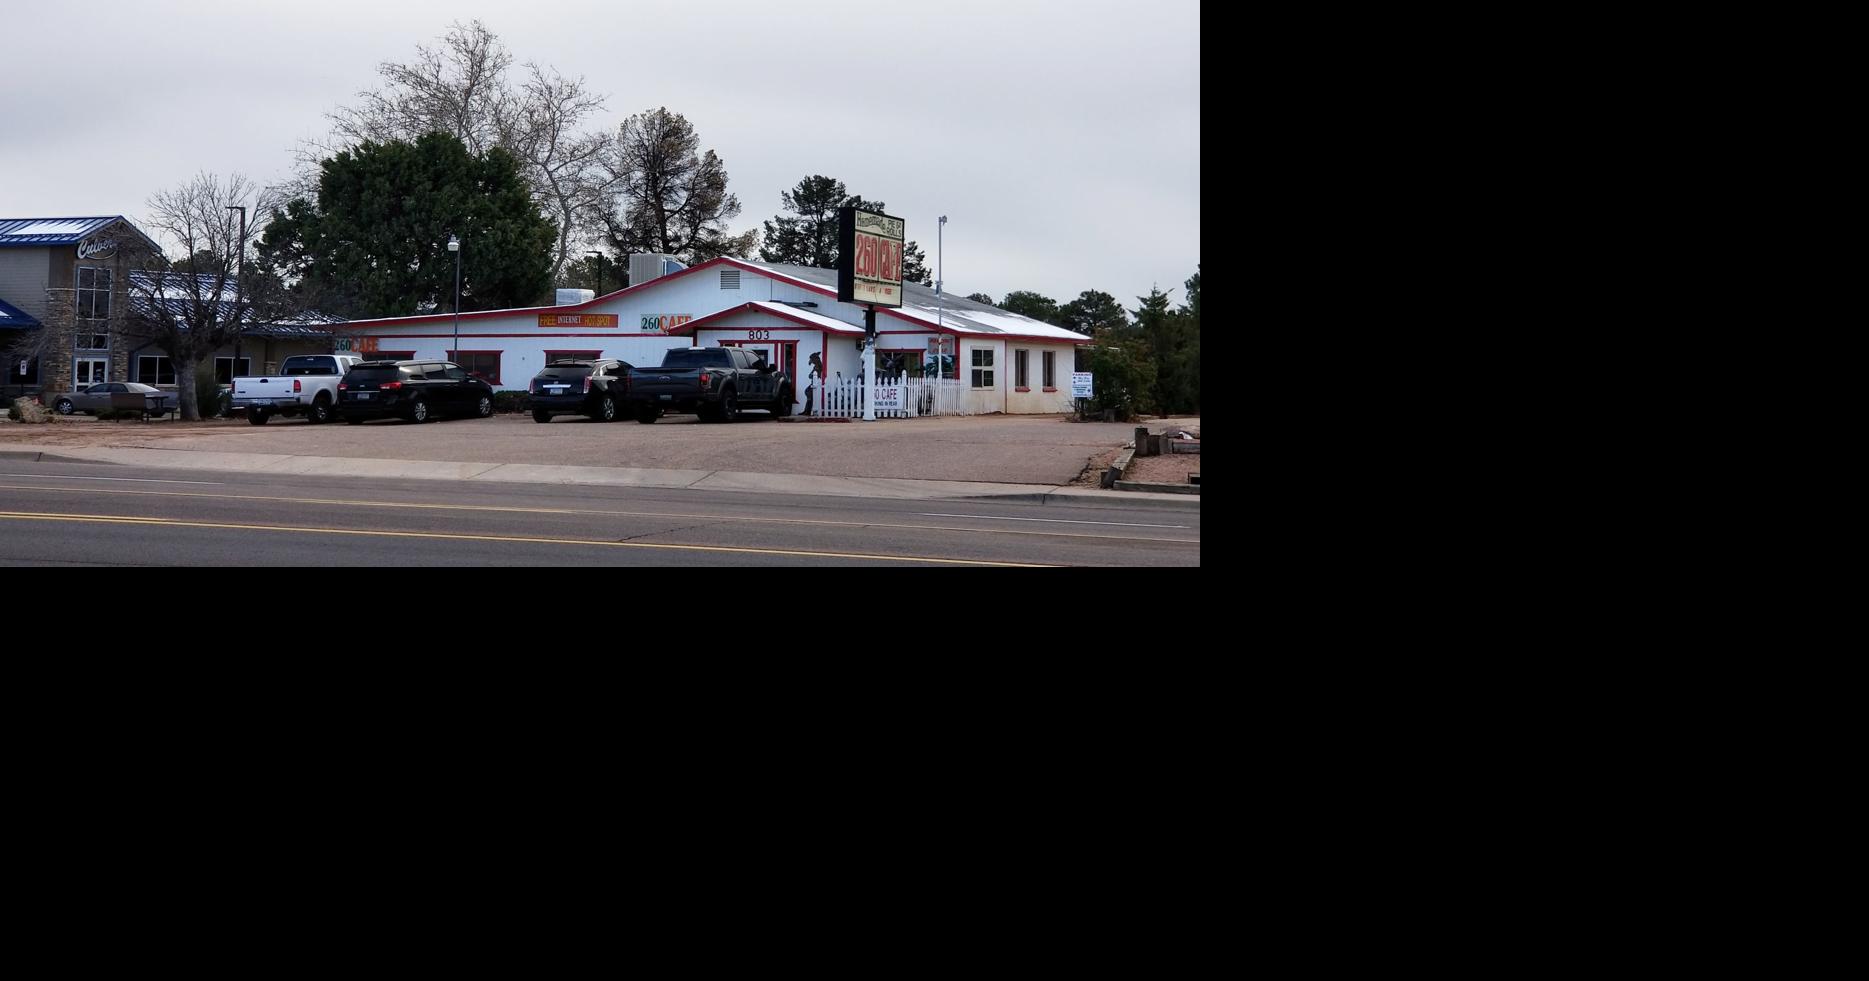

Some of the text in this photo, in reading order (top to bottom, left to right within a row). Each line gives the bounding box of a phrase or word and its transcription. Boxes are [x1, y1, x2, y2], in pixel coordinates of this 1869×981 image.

[856, 234, 877, 277] 260
[540, 315, 557, 326] FREE
[557, 315, 581, 324] INTERNET
[641, 317, 660, 330] 260
[748, 330, 770, 340] 803
[335, 339, 351, 351] 260
[882, 388, 897, 400] CAFE
